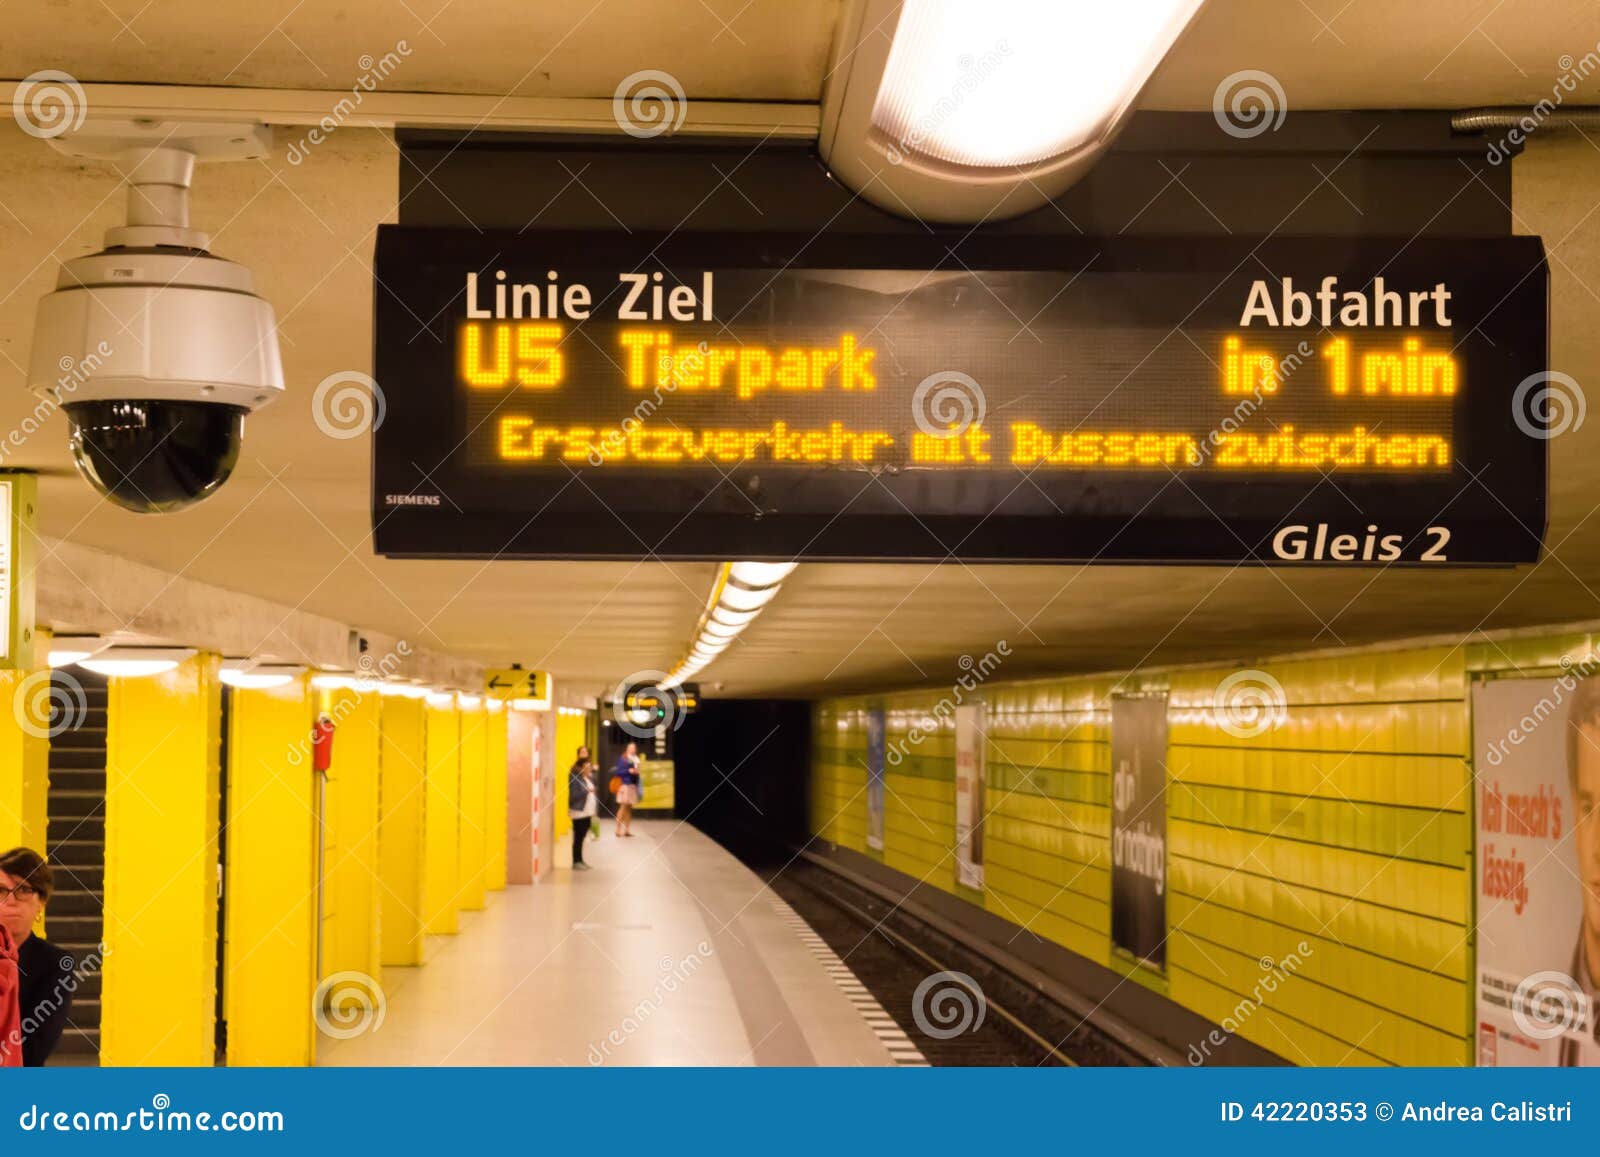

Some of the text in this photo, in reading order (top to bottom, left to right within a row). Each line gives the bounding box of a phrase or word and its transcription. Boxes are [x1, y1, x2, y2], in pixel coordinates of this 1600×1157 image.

[466, 271, 1452, 327] Linie Ziel Abfahrt
[463, 324, 1456, 398] U5 Tierpark in 1 min
[500, 416, 1449, 466] Ersatzverkehr mit Bussen zwischen
[385, 494, 440, 505] SIEMENS
[1272, 523, 1451, 561] Gleis 2
